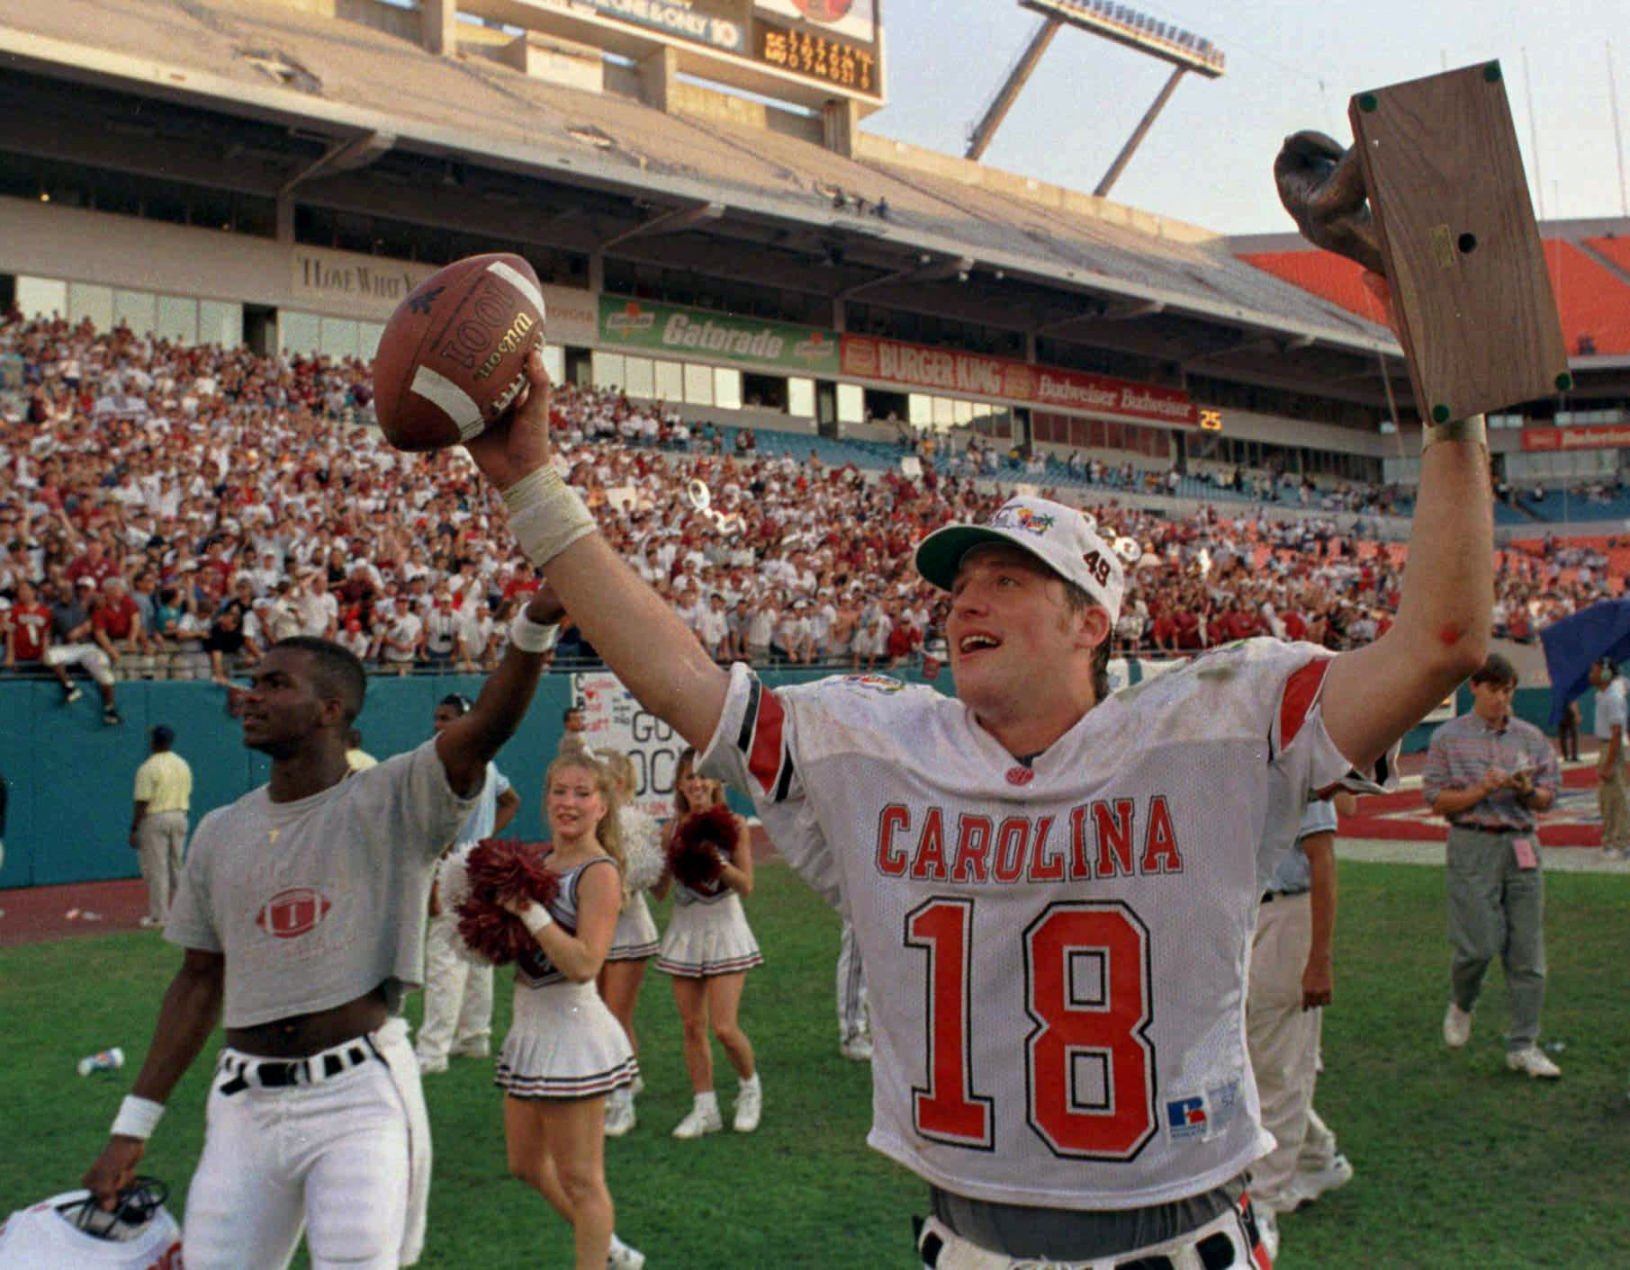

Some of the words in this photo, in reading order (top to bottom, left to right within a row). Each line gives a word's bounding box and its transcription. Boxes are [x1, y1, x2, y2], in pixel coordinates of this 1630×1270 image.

[711, 17, 739, 48] 10
[474, 312, 533, 379] Wilson
[662, 313, 783, 358] Gatorade
[878, 342, 953, 386] BURGER
[956, 355, 1001, 394] KING
[1037, 374, 1117, 408] Budweiser
[1121, 388, 1193, 418] Budweiser
[1200, 409, 1222, 432] 25
[1083, 550, 1111, 588] 49
[875, 795, 1184, 884] CAROLINA
[904, 896, 1159, 1163] 18
